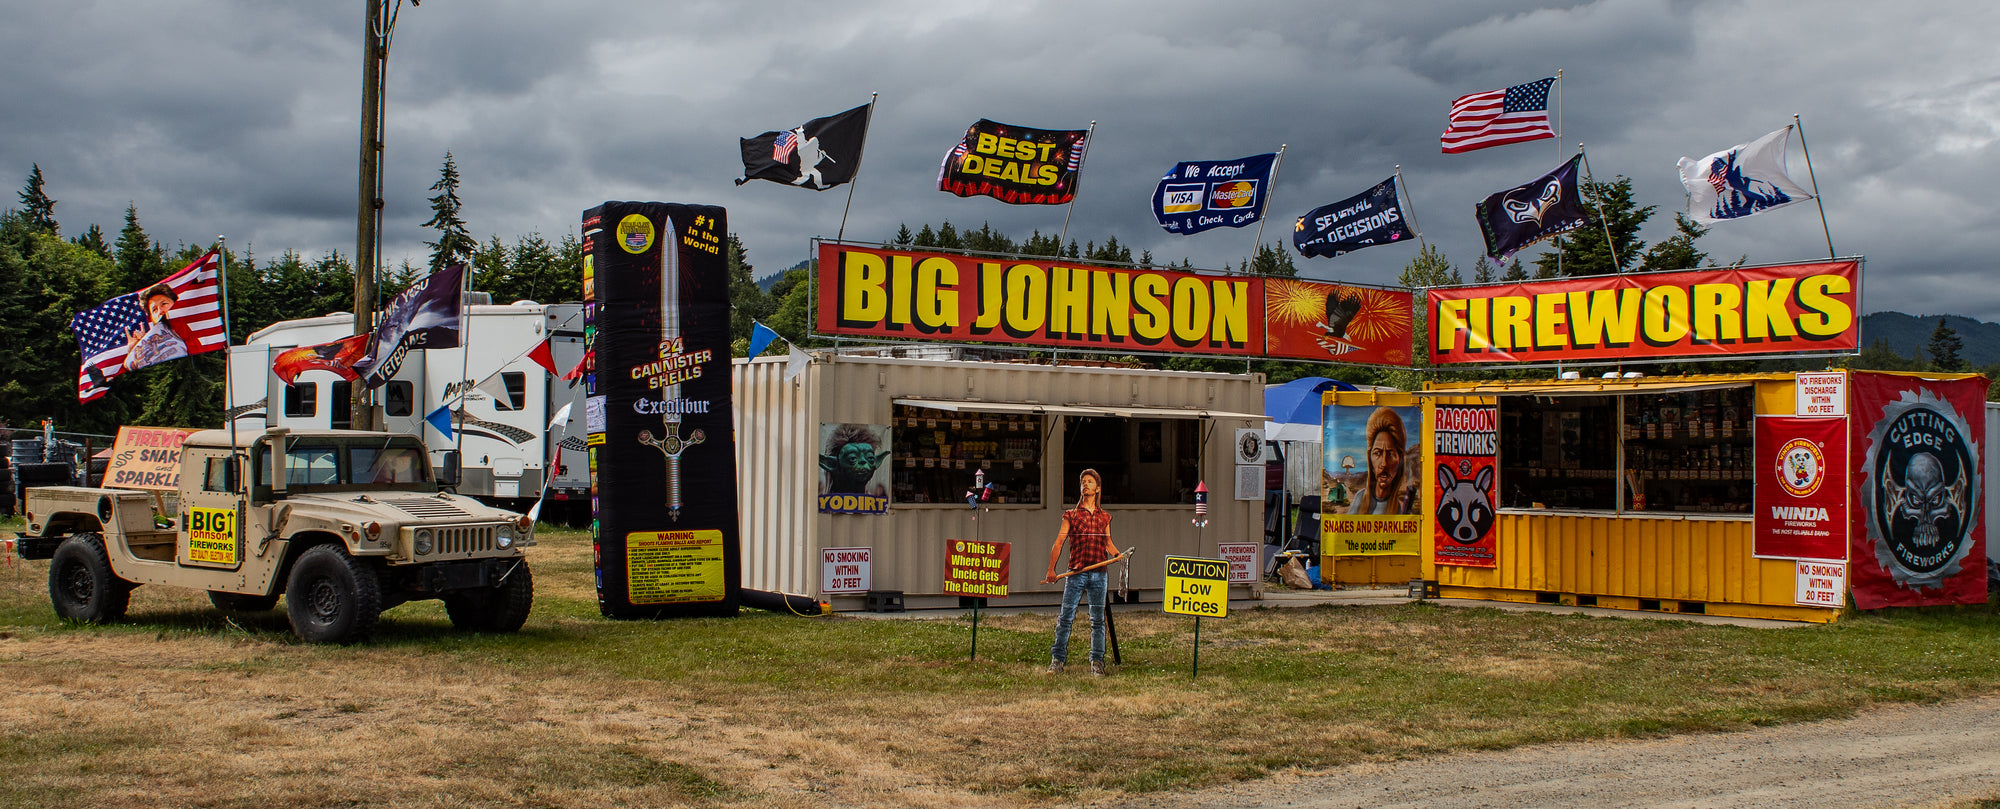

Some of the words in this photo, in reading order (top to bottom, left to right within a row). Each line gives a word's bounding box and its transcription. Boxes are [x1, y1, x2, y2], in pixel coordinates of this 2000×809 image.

[976, 132, 1056, 162] BEST
[962, 154, 1059, 186] DEALS
[1185, 165, 1200, 178] We
[1207, 163, 1245, 179] Accept
[1170, 192, 1194, 204] VISA
[1211, 187, 1255, 200] MasterCard
[1187, 218, 1193, 229] &
[1199, 215, 1224, 226] Check
[1233, 211, 1255, 224] Cards
[688, 226, 698, 237] in
[702, 231, 719, 243] the
[683, 236, 719, 255] World!
[402, 278, 430, 303] YOU
[841, 251, 960, 331] BIG
[972, 263, 1249, 345] JOHNSON
[1437, 274, 1852, 353] FIREWORKS
[659, 337, 685, 359] 24
[631, 349, 713, 380] CANNISTER
[649, 366, 702, 390] SHELLS
[1799, 377, 1808, 385] NO
[1809, 376, 1842, 385] FIREWORKS
[633, 397, 710, 415] Excalibur
[1807, 405, 1818, 413] 100
[1819, 405, 1834, 413] FEET
[1435, 407, 1496, 432] RACCOON
[1890, 412, 1955, 444] CUTTING
[125, 429, 194, 448] FIREWO
[1435, 433, 1496, 455] FIREWORKS
[1903, 432, 1944, 451] EDGE
[140, 449, 181, 464] SNAK
[154, 463, 176, 472] and
[819, 495, 887, 511] YODIRT
[192, 511, 226, 532] BIG
[1771, 506, 1830, 521] WINDA
[1323, 520, 1354, 533] SNAKES
[1356, 521, 1372, 533] AND
[1374, 520, 1417, 534] SPARKLERS
[1784, 520, 1817, 528] FIREWORKS
[190, 528, 227, 541] johnson
[657, 532, 694, 541] WARNING
[190, 540, 234, 551] FIREWORKS
[967, 542, 985, 554] This
[987, 543, 995, 555] Is
[1229, 546, 1255, 554] FIREWORKS
[1360, 540, 1376, 553] good
[1896, 540, 1955, 567] FIREWORKS
[825, 552, 835, 563] NO
[837, 552, 869, 563] SMOKING
[951, 554, 980, 567] Where
[982, 556, 1002, 569] Your
[835, 565, 859, 576] WITHIN
[952, 567, 977, 580] Uncle
[979, 569, 999, 582] Gets
[1169, 561, 1226, 578] CAUTION
[1800, 565, 1809, 575] NO
[1811, 566, 1843, 577] SMOKING
[832, 578, 841, 589] 20
[843, 577, 862, 588] FEET
[944, 580, 961, 593] The
[962, 581, 985, 594] Good
[986, 583, 1008, 596] Stuff
[1181, 579, 1211, 595] Low
[1809, 578, 1833, 589] WITHIN
[1806, 590, 1815, 600] 20
[1817, 591, 1834, 602] FEET
[1172, 596, 1218, 614] Prices
